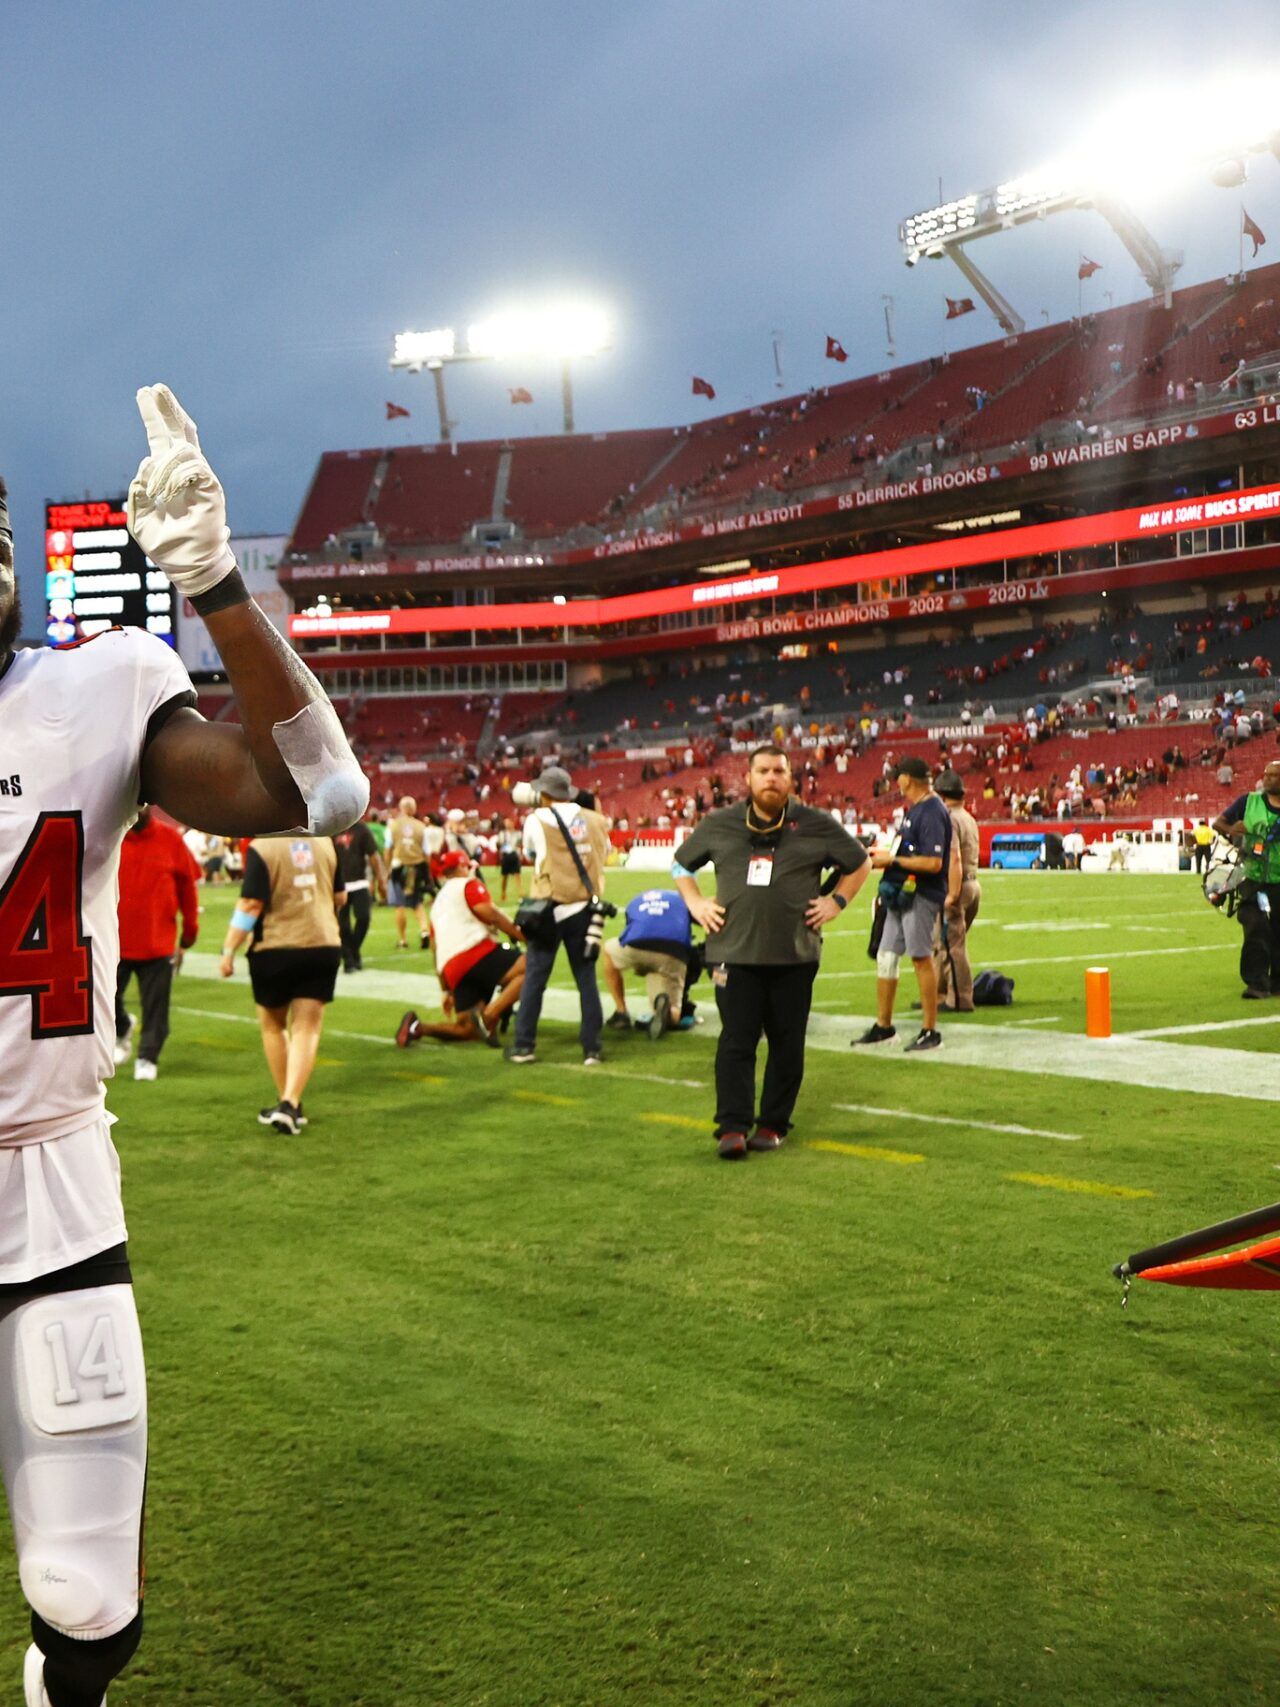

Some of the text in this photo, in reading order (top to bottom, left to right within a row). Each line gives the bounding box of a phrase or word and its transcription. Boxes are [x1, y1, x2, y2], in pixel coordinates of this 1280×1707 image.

[1235, 410, 1257, 429] 63
[1030, 426, 1182, 471] 99 WARREN SAPP
[838, 468, 987, 510] 55 DERRICK BROOKS
[717, 516, 746, 534] MIKE
[749, 504, 804, 527] ALSTOTT
[1139, 511, 1160, 529] MIX
[1175, 505, 1204, 523] SOME
[1205, 498, 1237, 518] BUCS
[292, 562, 388, 579] BRUCE ARIANS
[434, 556, 482, 572] RONDE
[717, 617, 761, 641] SUPER
[763, 612, 802, 633] BOWL
[806, 603, 889, 630] CHAMPIONS
[909, 596, 944, 615] 2002
[989, 583, 1027, 604] 2020
[45, 1315, 126, 1405] 14
